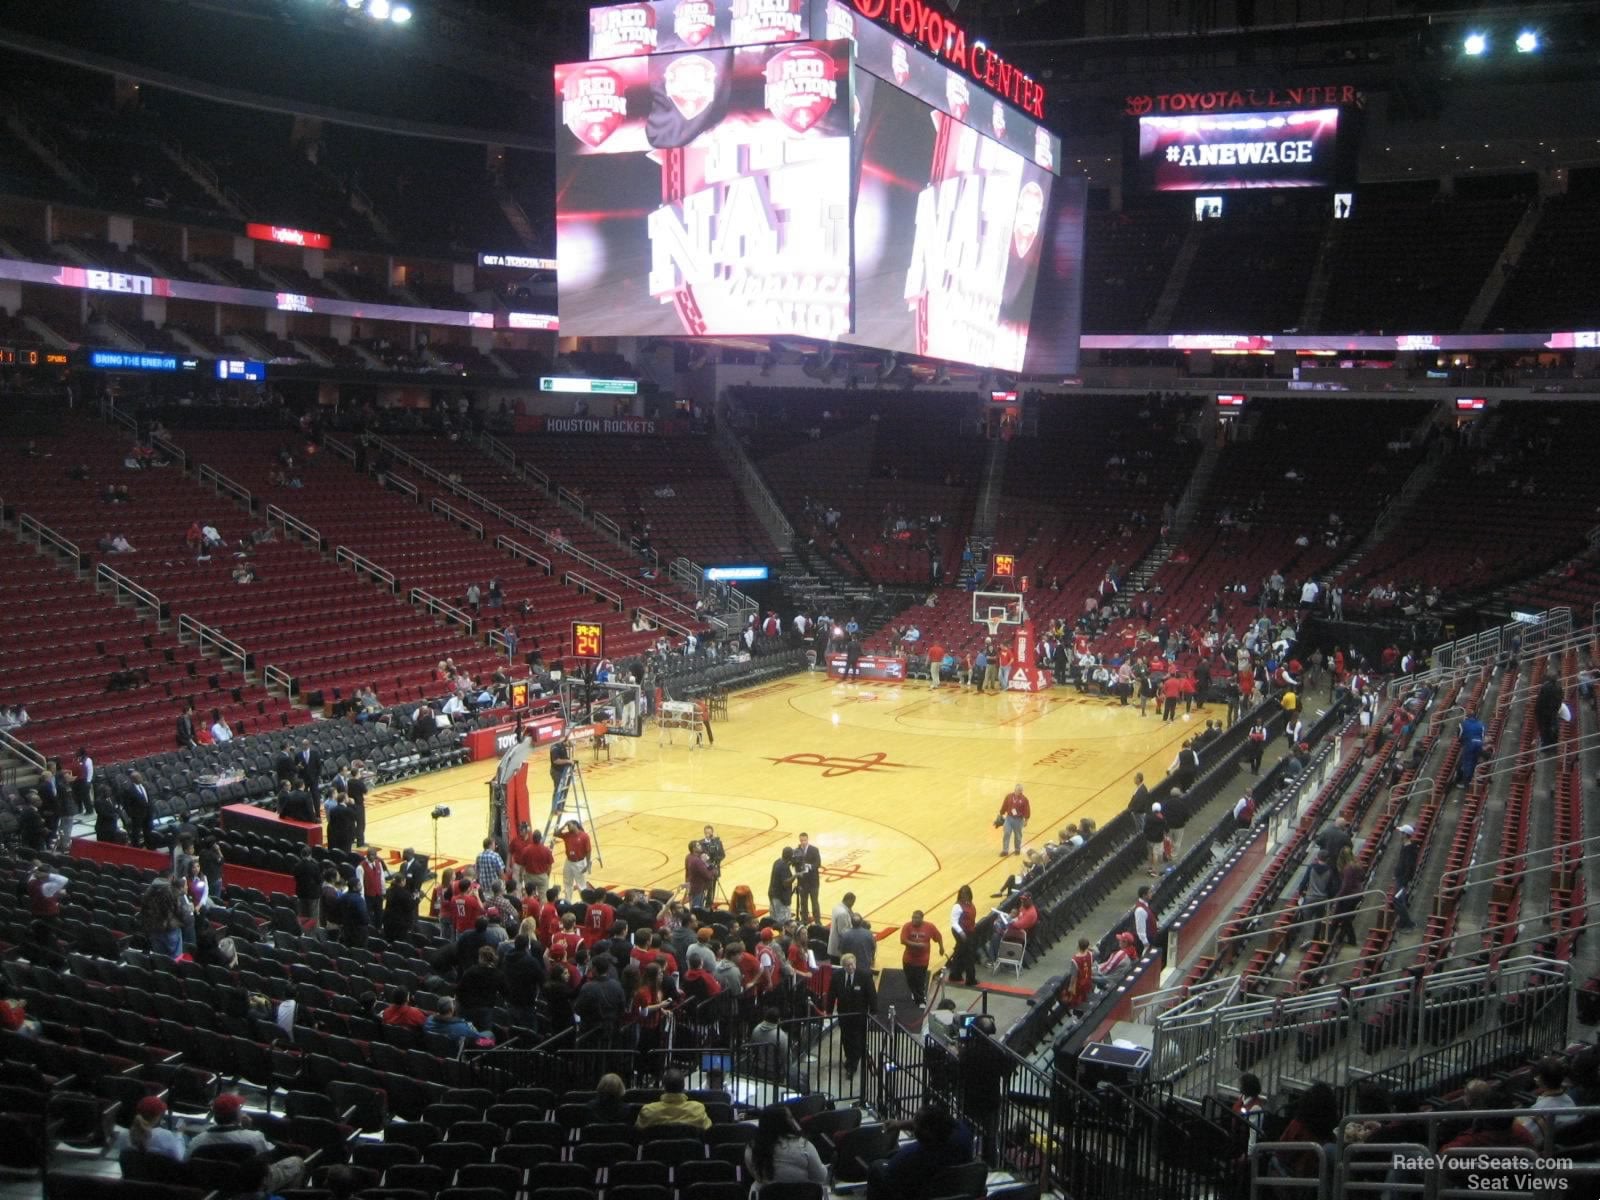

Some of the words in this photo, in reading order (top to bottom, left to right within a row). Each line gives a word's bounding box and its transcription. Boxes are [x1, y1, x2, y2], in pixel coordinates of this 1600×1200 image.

[890, 0, 967, 69] TOYOTA
[971, 45, 1046, 119] CENTER
[1157, 91, 1243, 111] TOYOTA
[1165, 140, 1313, 167] #ANEWAGE
[95, 353, 122, 365] BRING
[123, 356, 140, 366] THE
[547, 418, 600, 433] HOUSTON
[603, 419, 656, 434] ROCKETS
[996, 563, 1011, 574] 24
[576, 625, 600, 636] 39:24
[578, 637, 598, 654] 24
[1008, 680, 1032, 691] PEAK
[592, 915, 601, 928] 13
